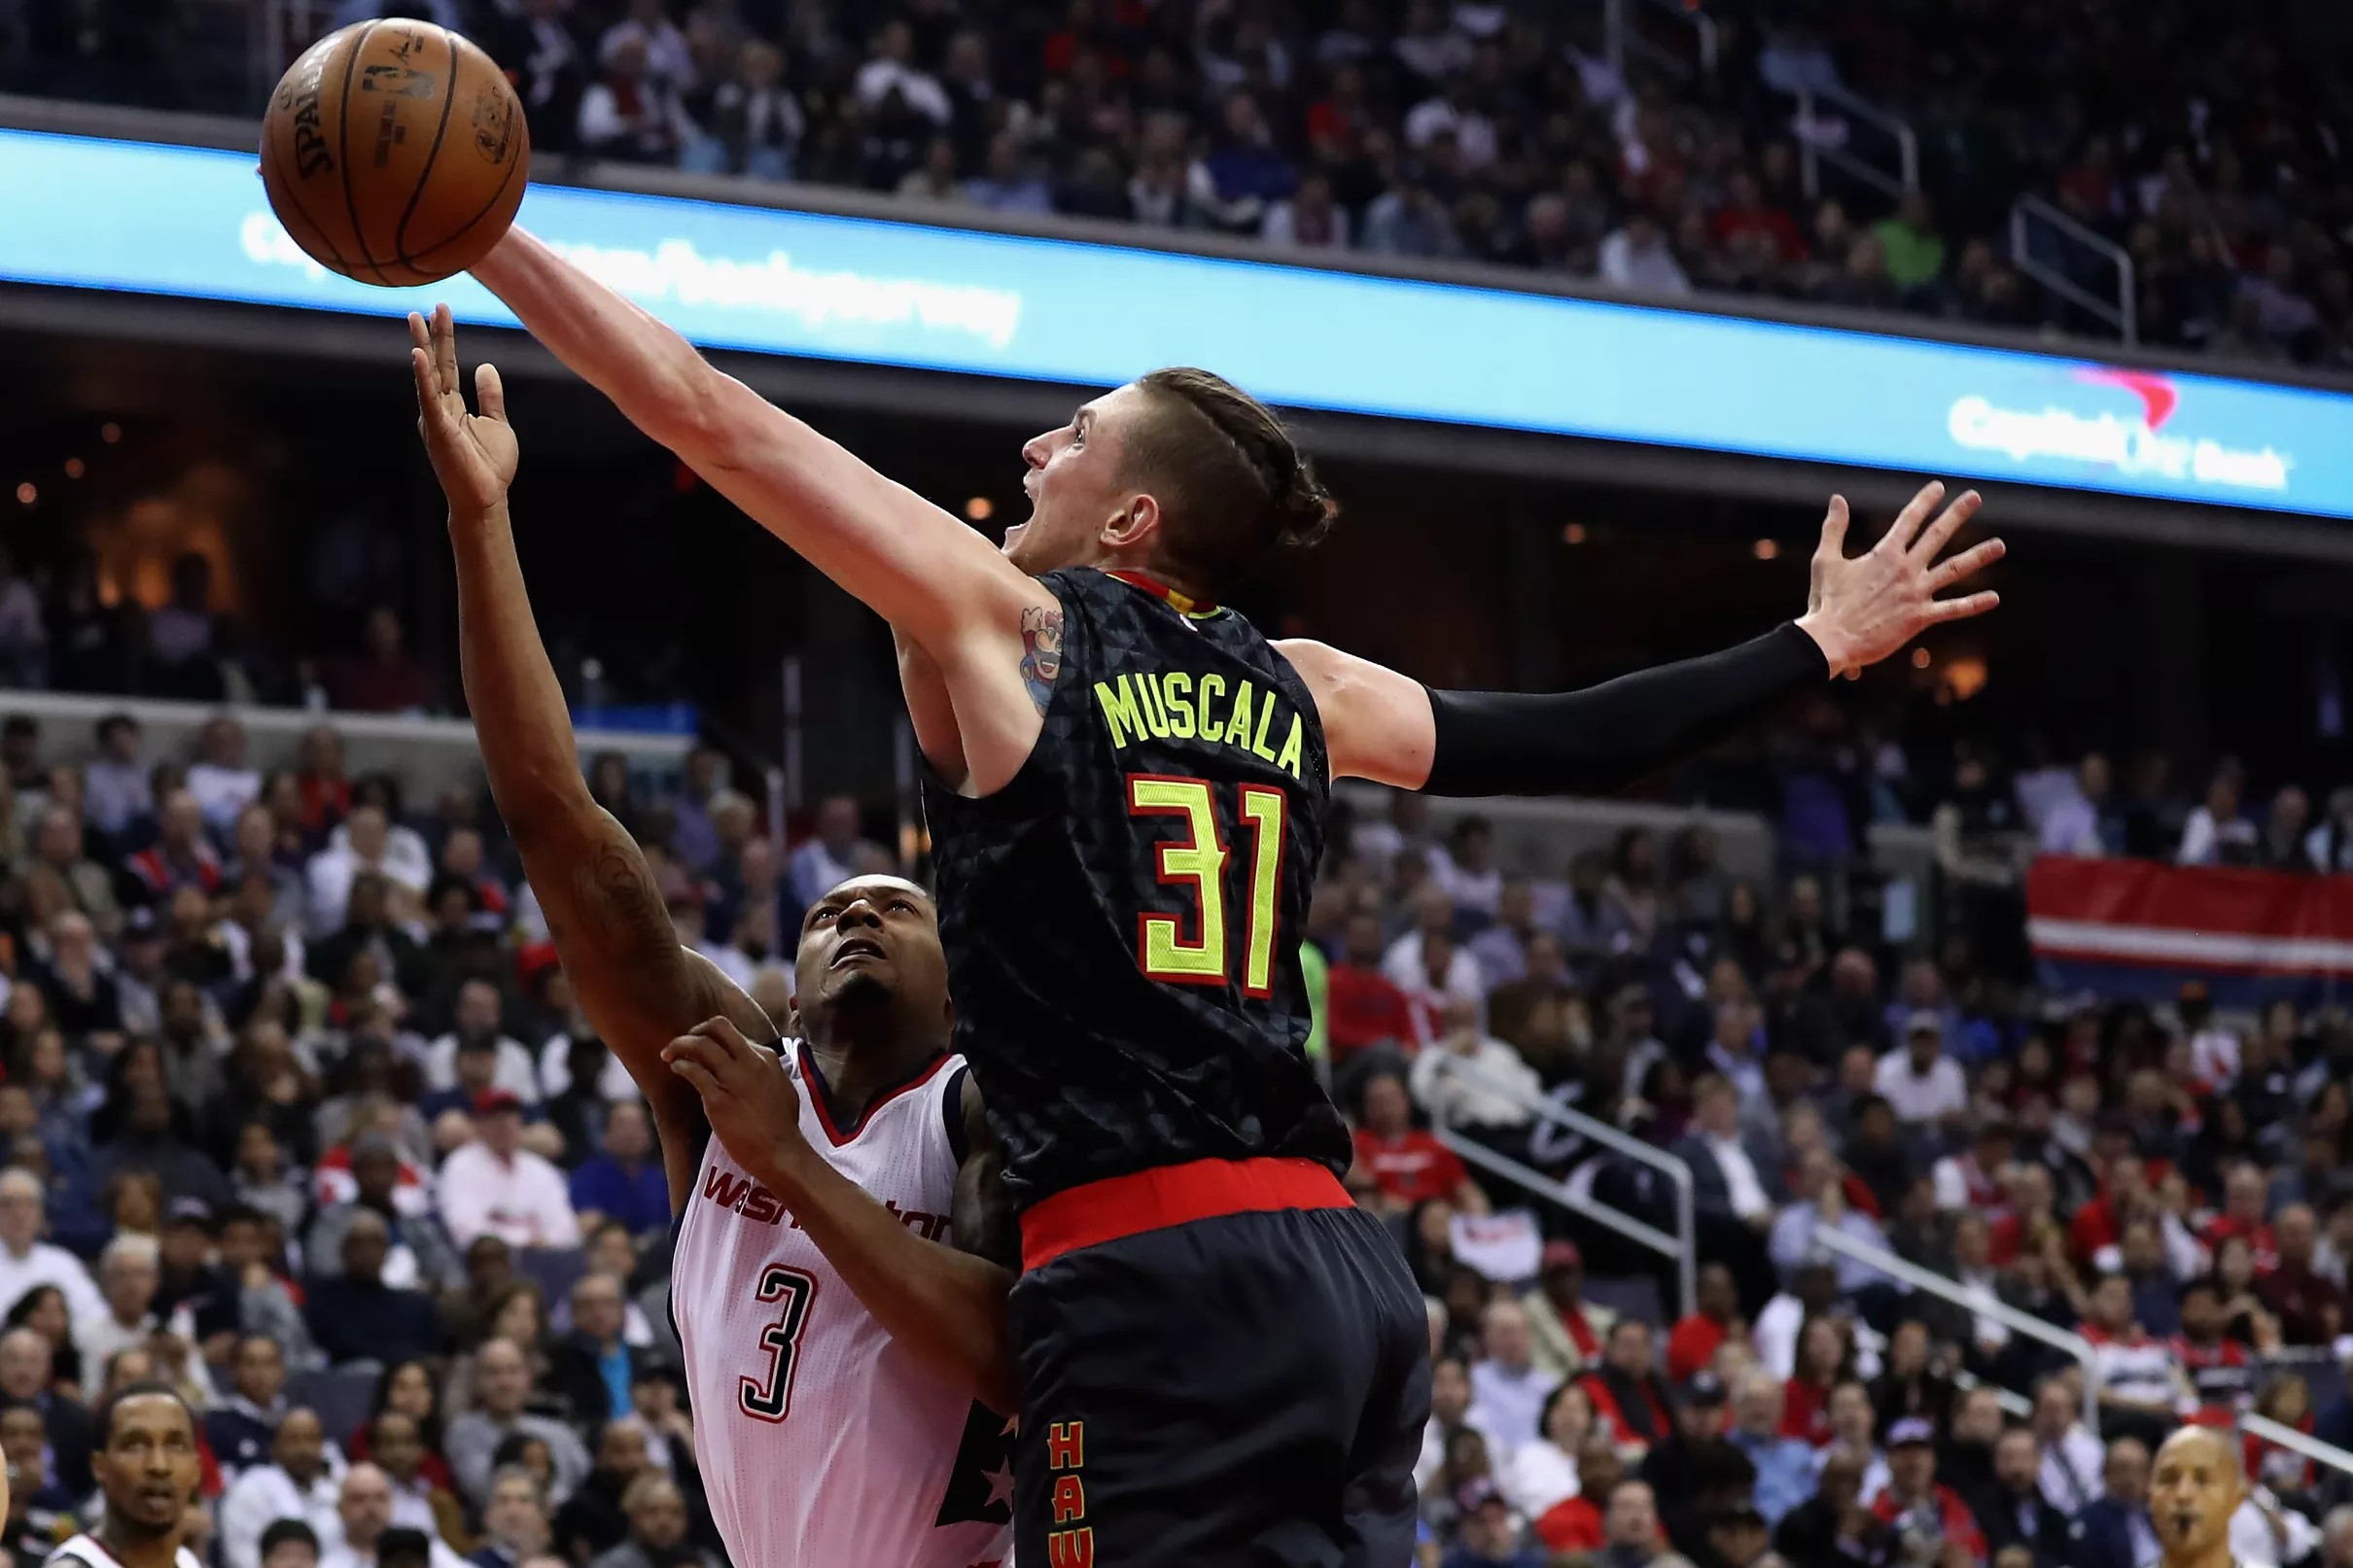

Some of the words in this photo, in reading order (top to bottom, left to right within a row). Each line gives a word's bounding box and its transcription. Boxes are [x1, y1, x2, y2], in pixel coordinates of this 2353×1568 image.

[1094, 672, 1303, 780] MUSCALA
[1126, 773, 1286, 1000] 31
[738, 1264, 819, 1423] 3
